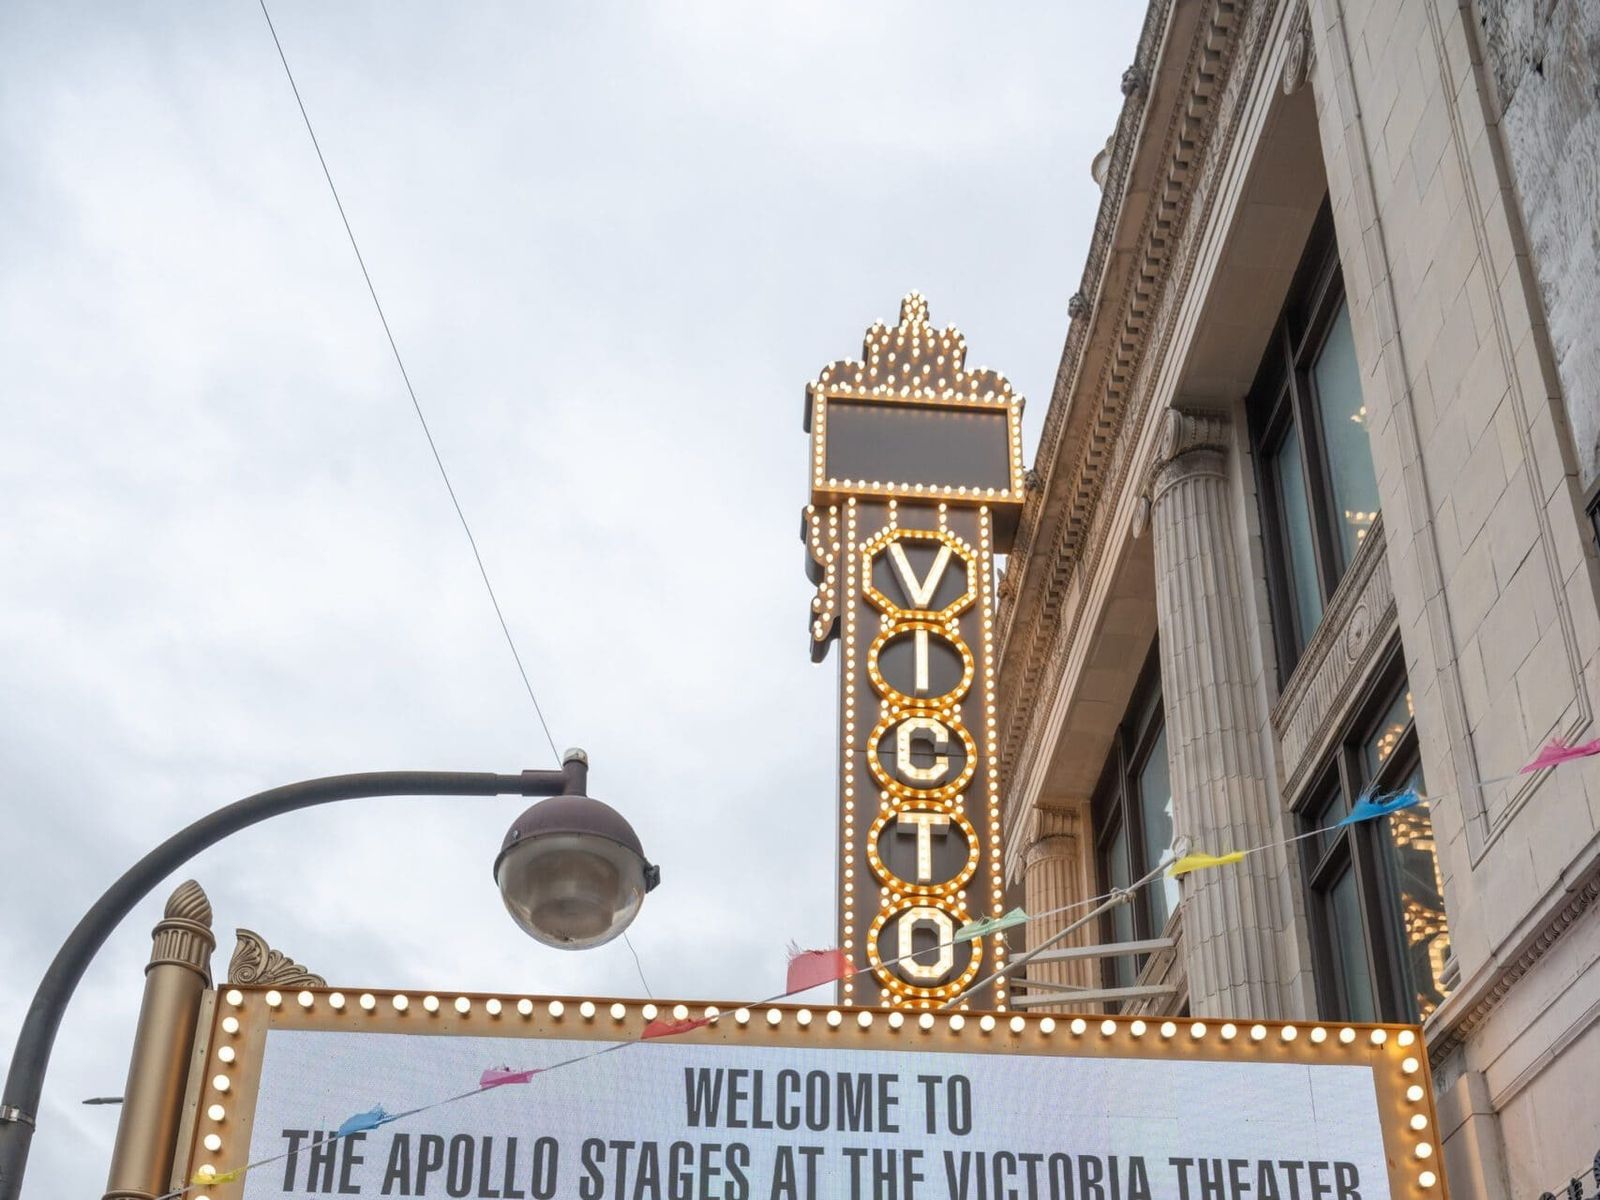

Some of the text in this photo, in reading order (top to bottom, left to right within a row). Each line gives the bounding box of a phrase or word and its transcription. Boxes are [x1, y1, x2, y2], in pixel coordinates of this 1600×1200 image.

[684, 1067, 972, 1136] WELCOME TO
[282, 1129, 367, 1195] THE
[380, 1132, 559, 1200] APOLLO
